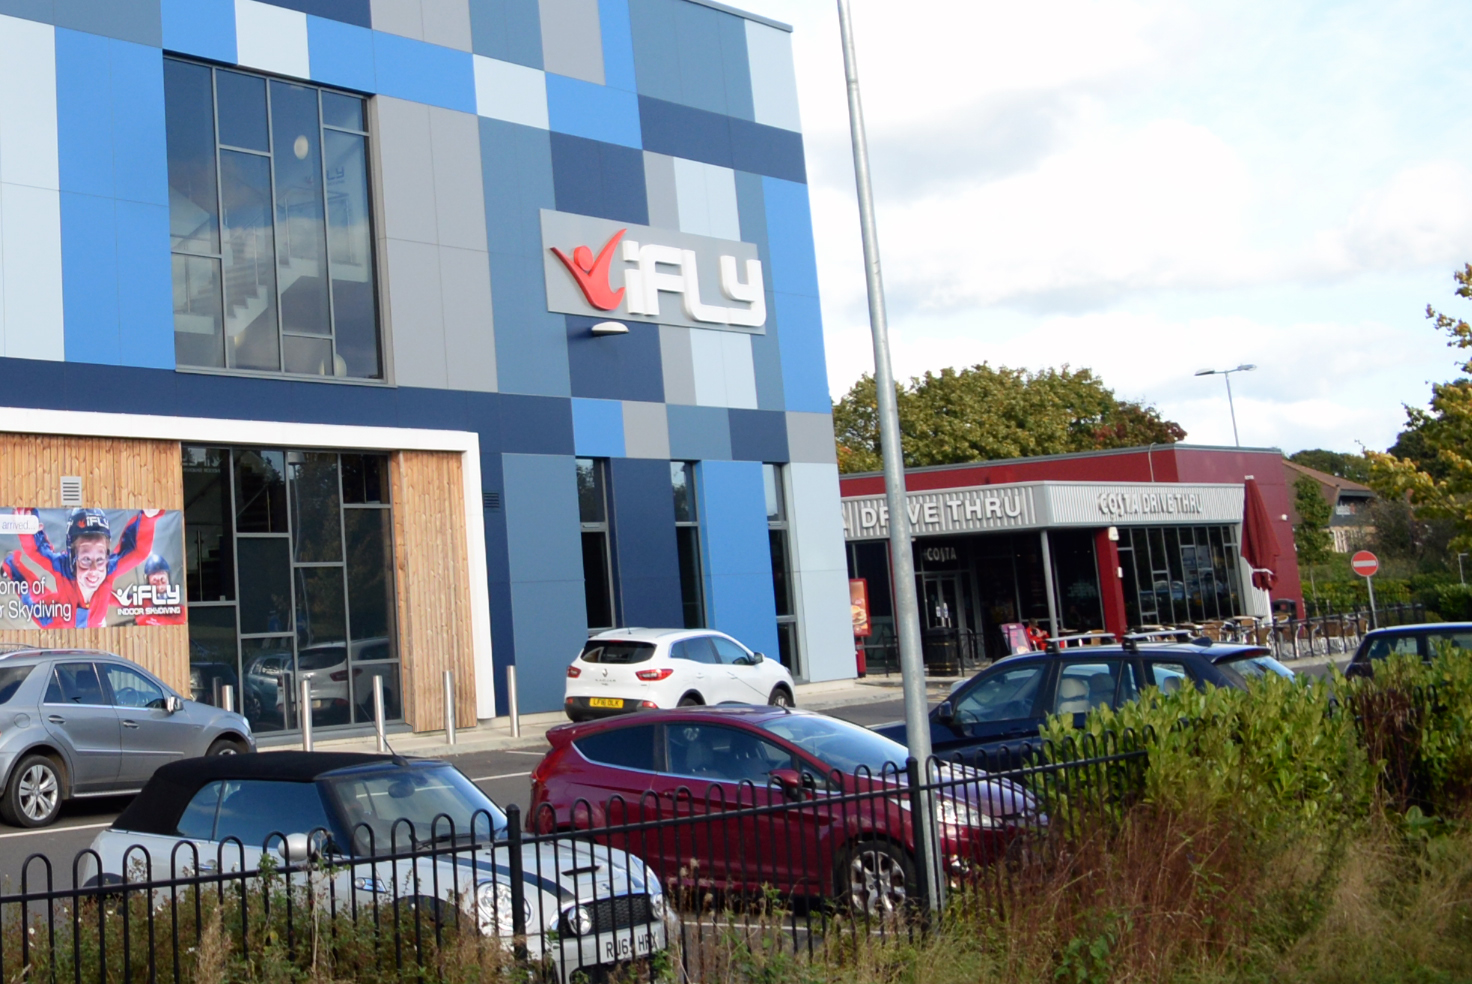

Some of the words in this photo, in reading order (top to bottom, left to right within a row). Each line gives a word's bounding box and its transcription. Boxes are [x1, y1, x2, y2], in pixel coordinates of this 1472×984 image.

[622, 240, 767, 327] iFLY
[861, 502, 940, 529] DRVE
[947, 495, 1022, 522] THRU
[1098, 493, 1138, 517] COSTA
[1141, 494, 1174, 514] DRIVE
[1174, 495, 1203, 514] THRU
[32, 576, 46, 595] of
[132, 584, 181, 606] iFLY
[8, 600, 72, 622] Skydiving
[117, 607, 144, 615] INDOOR
[145, 606, 181, 615] SKYDIVING
